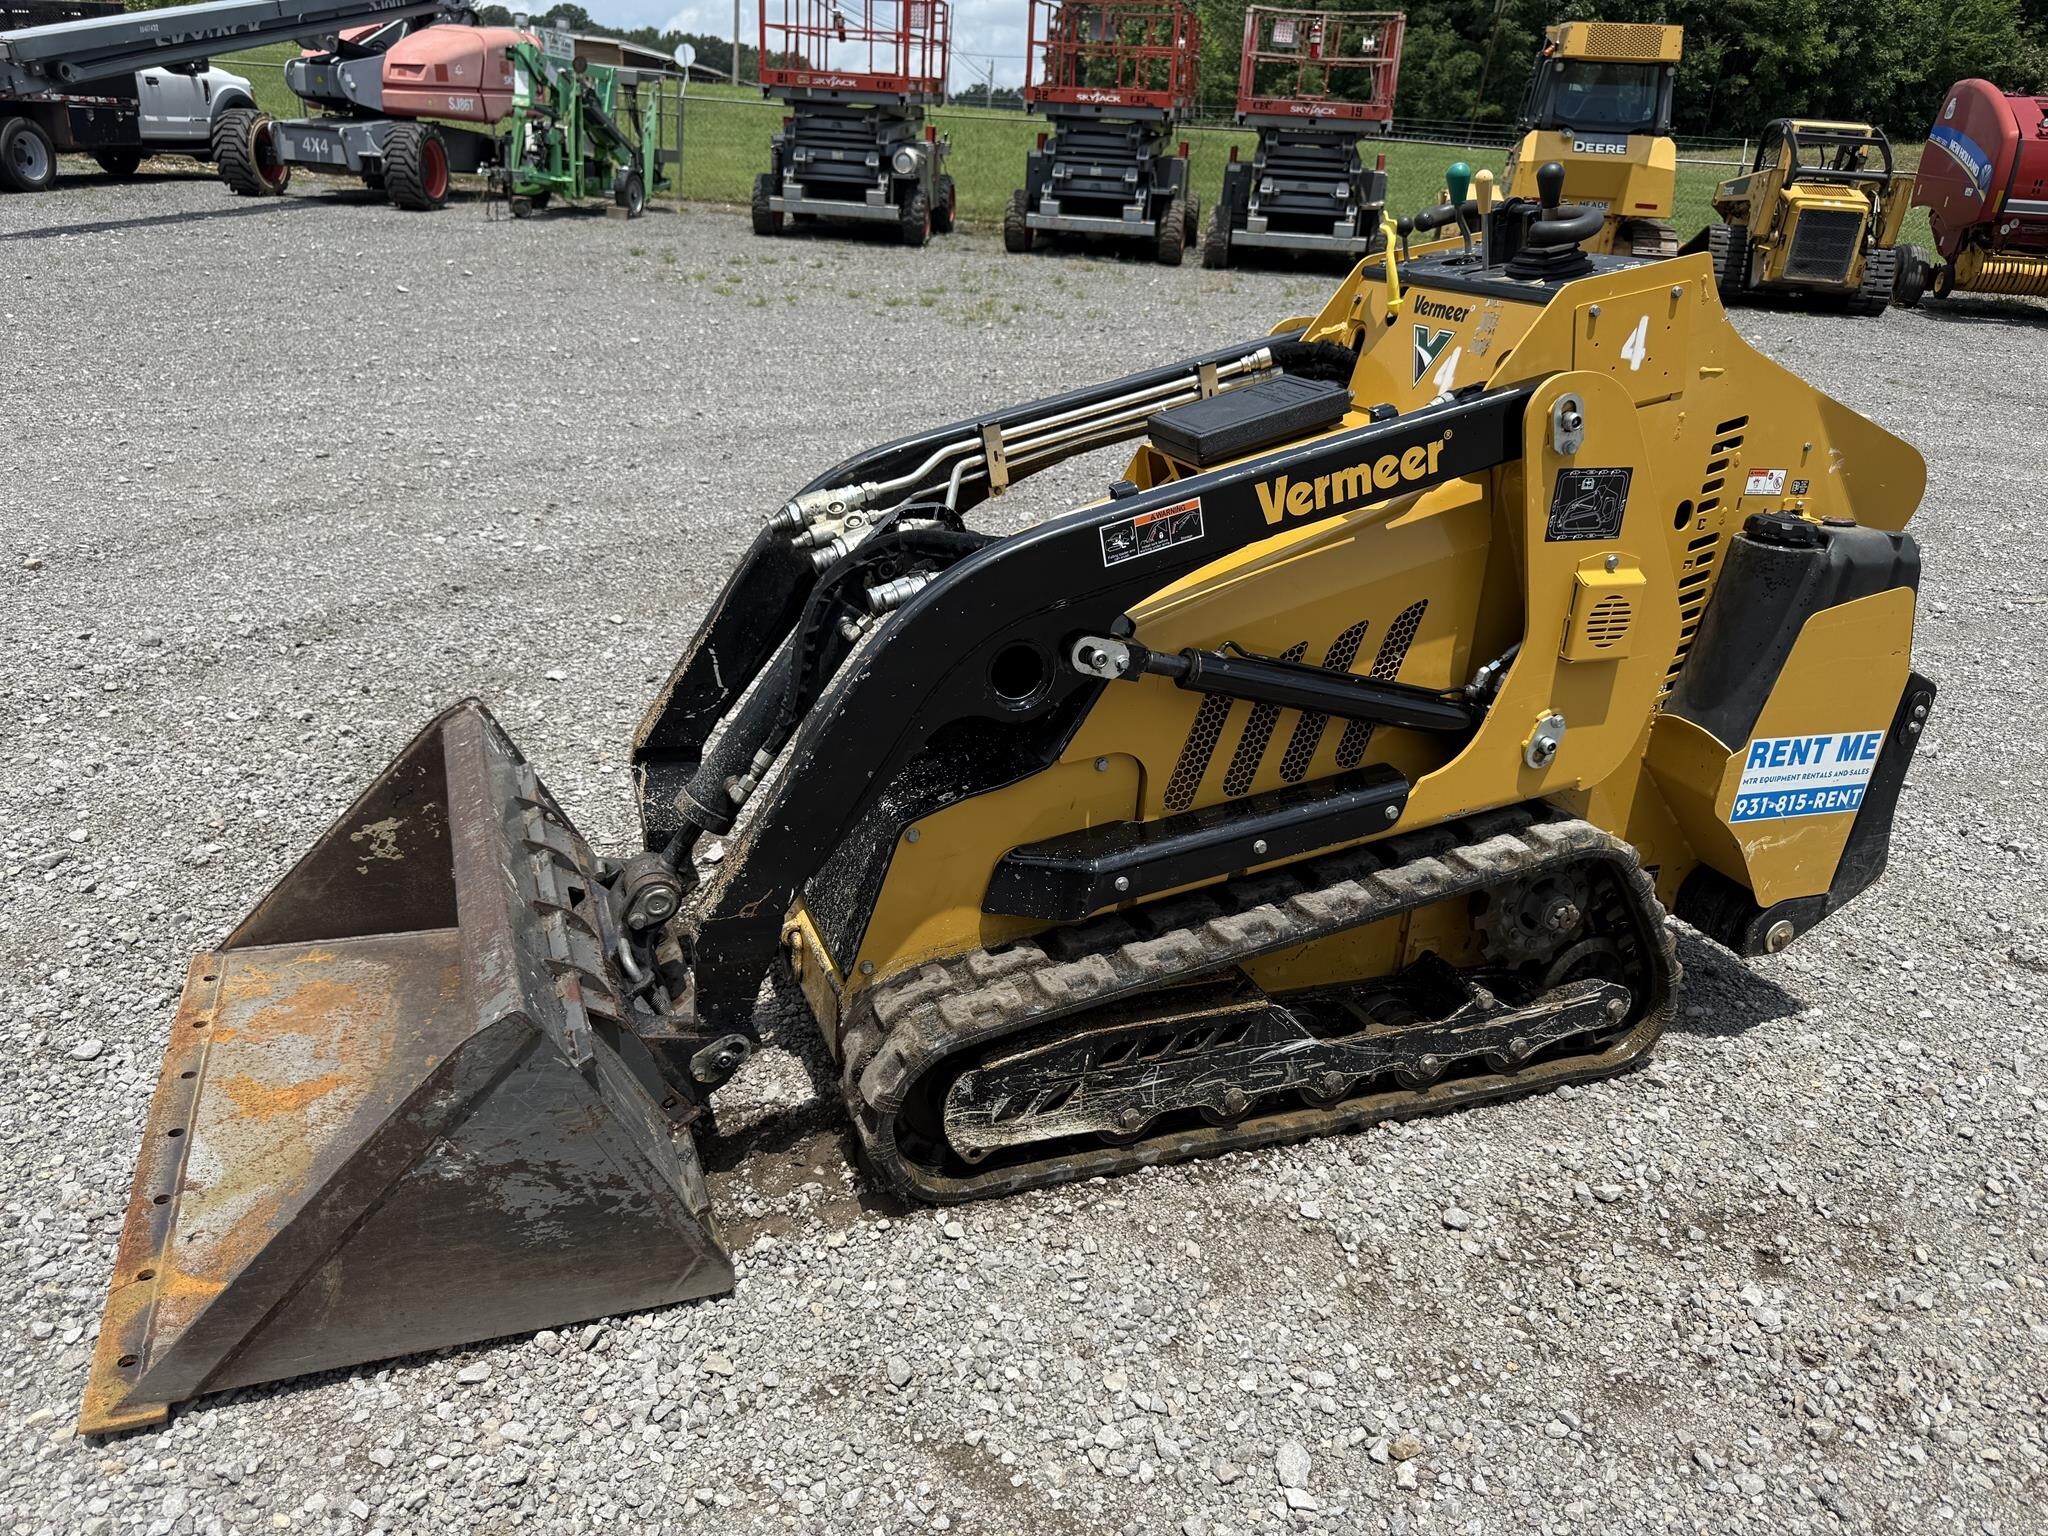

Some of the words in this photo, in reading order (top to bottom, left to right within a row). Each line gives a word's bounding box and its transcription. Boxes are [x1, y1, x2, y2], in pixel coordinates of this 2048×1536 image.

[813, 76, 857, 88] SKYJACK
[1076, 91, 1121, 103] SKYJACK
[1290, 105, 1337, 116] SKYJACK
[302, 136, 329, 154] 4X4
[1573, 140, 1627, 154] DEERE
[1958, 147, 1980, 177] HOLLAND
[1413, 294, 1471, 323] Vermeer
[1620, 315, 1650, 371] 4
[1432, 346, 1462, 396] 4
[1255, 439, 1445, 525] Vermeer
[1155, 504, 1186, 519] WARNING
[1747, 737, 1832, 769] RENT
[1836, 733, 1882, 762] ME
[1759, 774, 1801, 784] EQUIPMENT
[1801, 771, 1832, 780] RENTALS
[1849, 768, 1870, 776] SALES
[1735, 788, 1863, 817] 931-815-RENT
